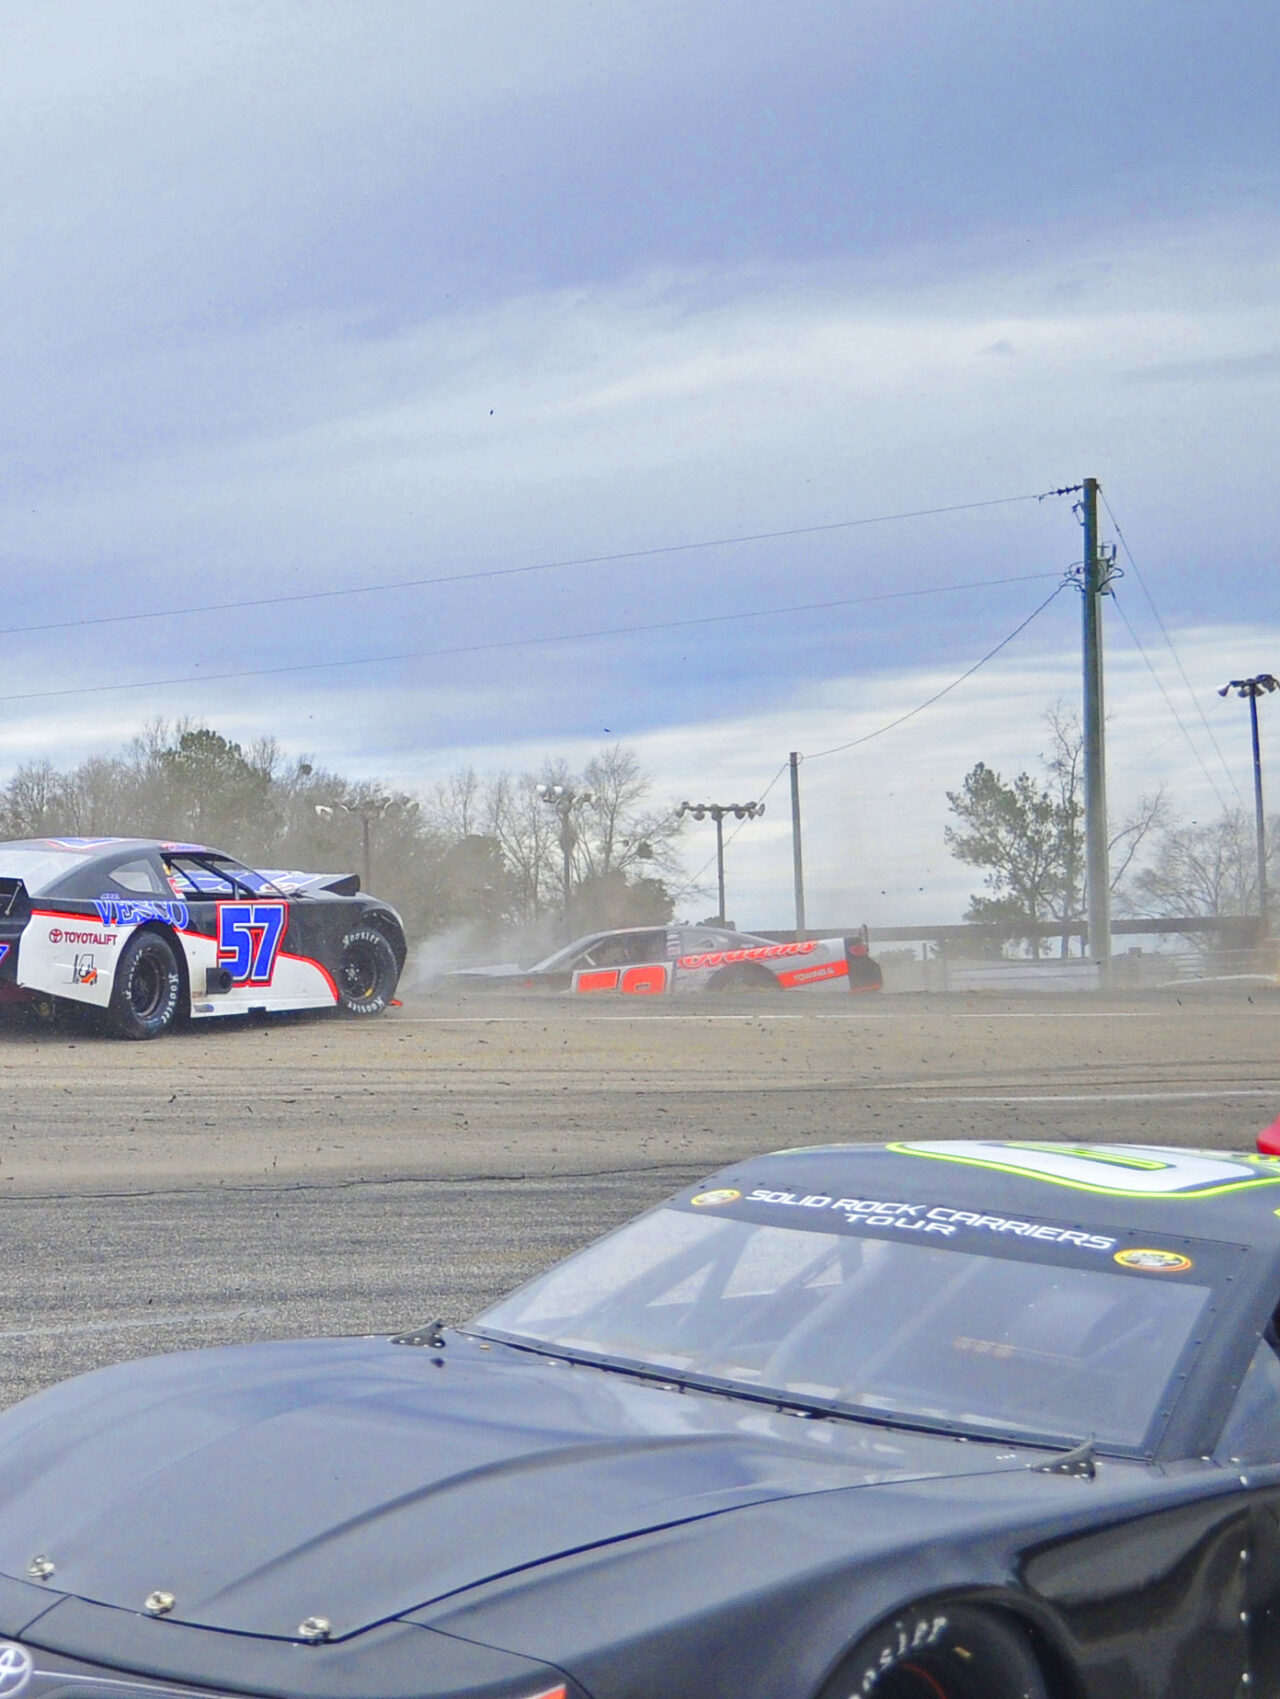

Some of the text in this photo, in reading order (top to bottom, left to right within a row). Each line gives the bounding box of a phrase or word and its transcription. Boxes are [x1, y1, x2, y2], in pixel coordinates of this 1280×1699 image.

[63, 930, 118, 946] TOYOTALIFT
[215, 899, 289, 988] 57
[745, 1189, 833, 1208] SOLID
[831, 1198, 920, 1219] ROCK
[924, 1206, 1117, 1251] CARRIERS
[844, 1212, 957, 1237] TOUR
